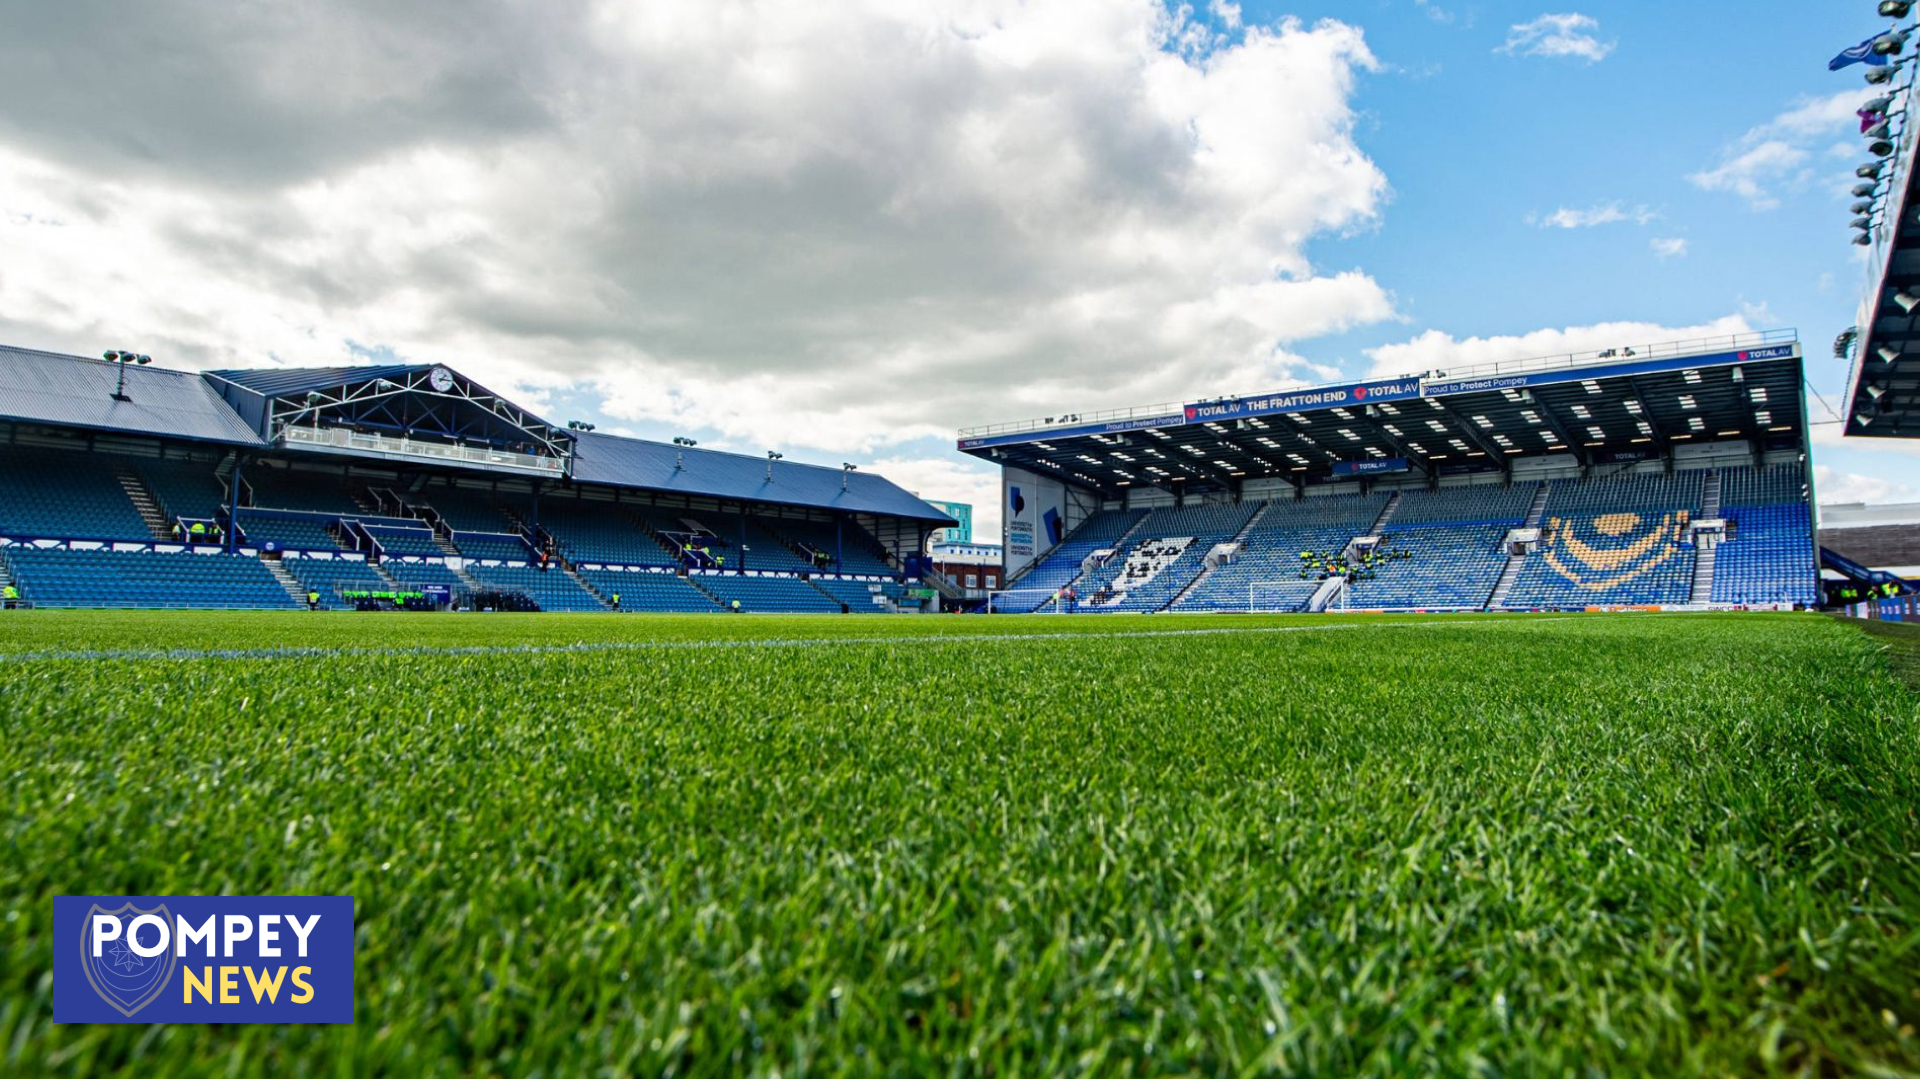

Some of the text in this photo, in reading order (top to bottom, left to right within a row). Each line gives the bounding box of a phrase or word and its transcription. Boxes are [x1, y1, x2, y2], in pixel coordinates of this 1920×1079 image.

[1368, 385, 1402, 397] TOTAL
[1424, 377, 1528, 394] Proud to Protect Pompey
[1247, 391, 1347, 411] THE FRATTON END
[1198, 405, 1228, 417] TOTAL
[1106, 422, 1124, 431] Proud
[1133, 419, 1157, 428] Protect
[1157, 416, 1183, 425] Pompey
